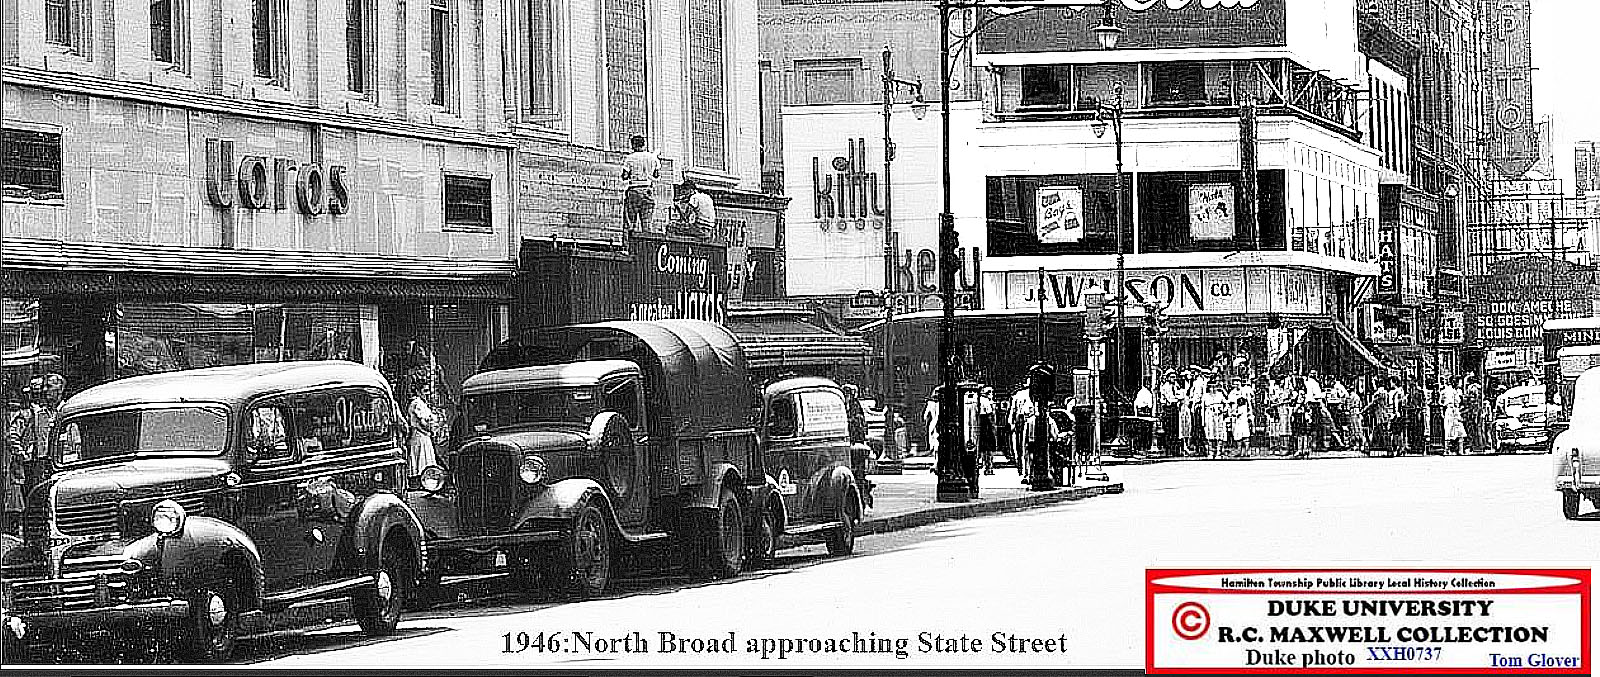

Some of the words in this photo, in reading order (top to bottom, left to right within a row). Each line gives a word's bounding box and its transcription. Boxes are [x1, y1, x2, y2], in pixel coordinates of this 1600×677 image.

[657, 244, 708, 288] Coming
[1380, 231, 1393, 286] HATS
[1048, 274, 1204, 311] WSON
[1477, 328, 1513, 339] LOUIS
[1497, 315, 1530, 326] GOES
